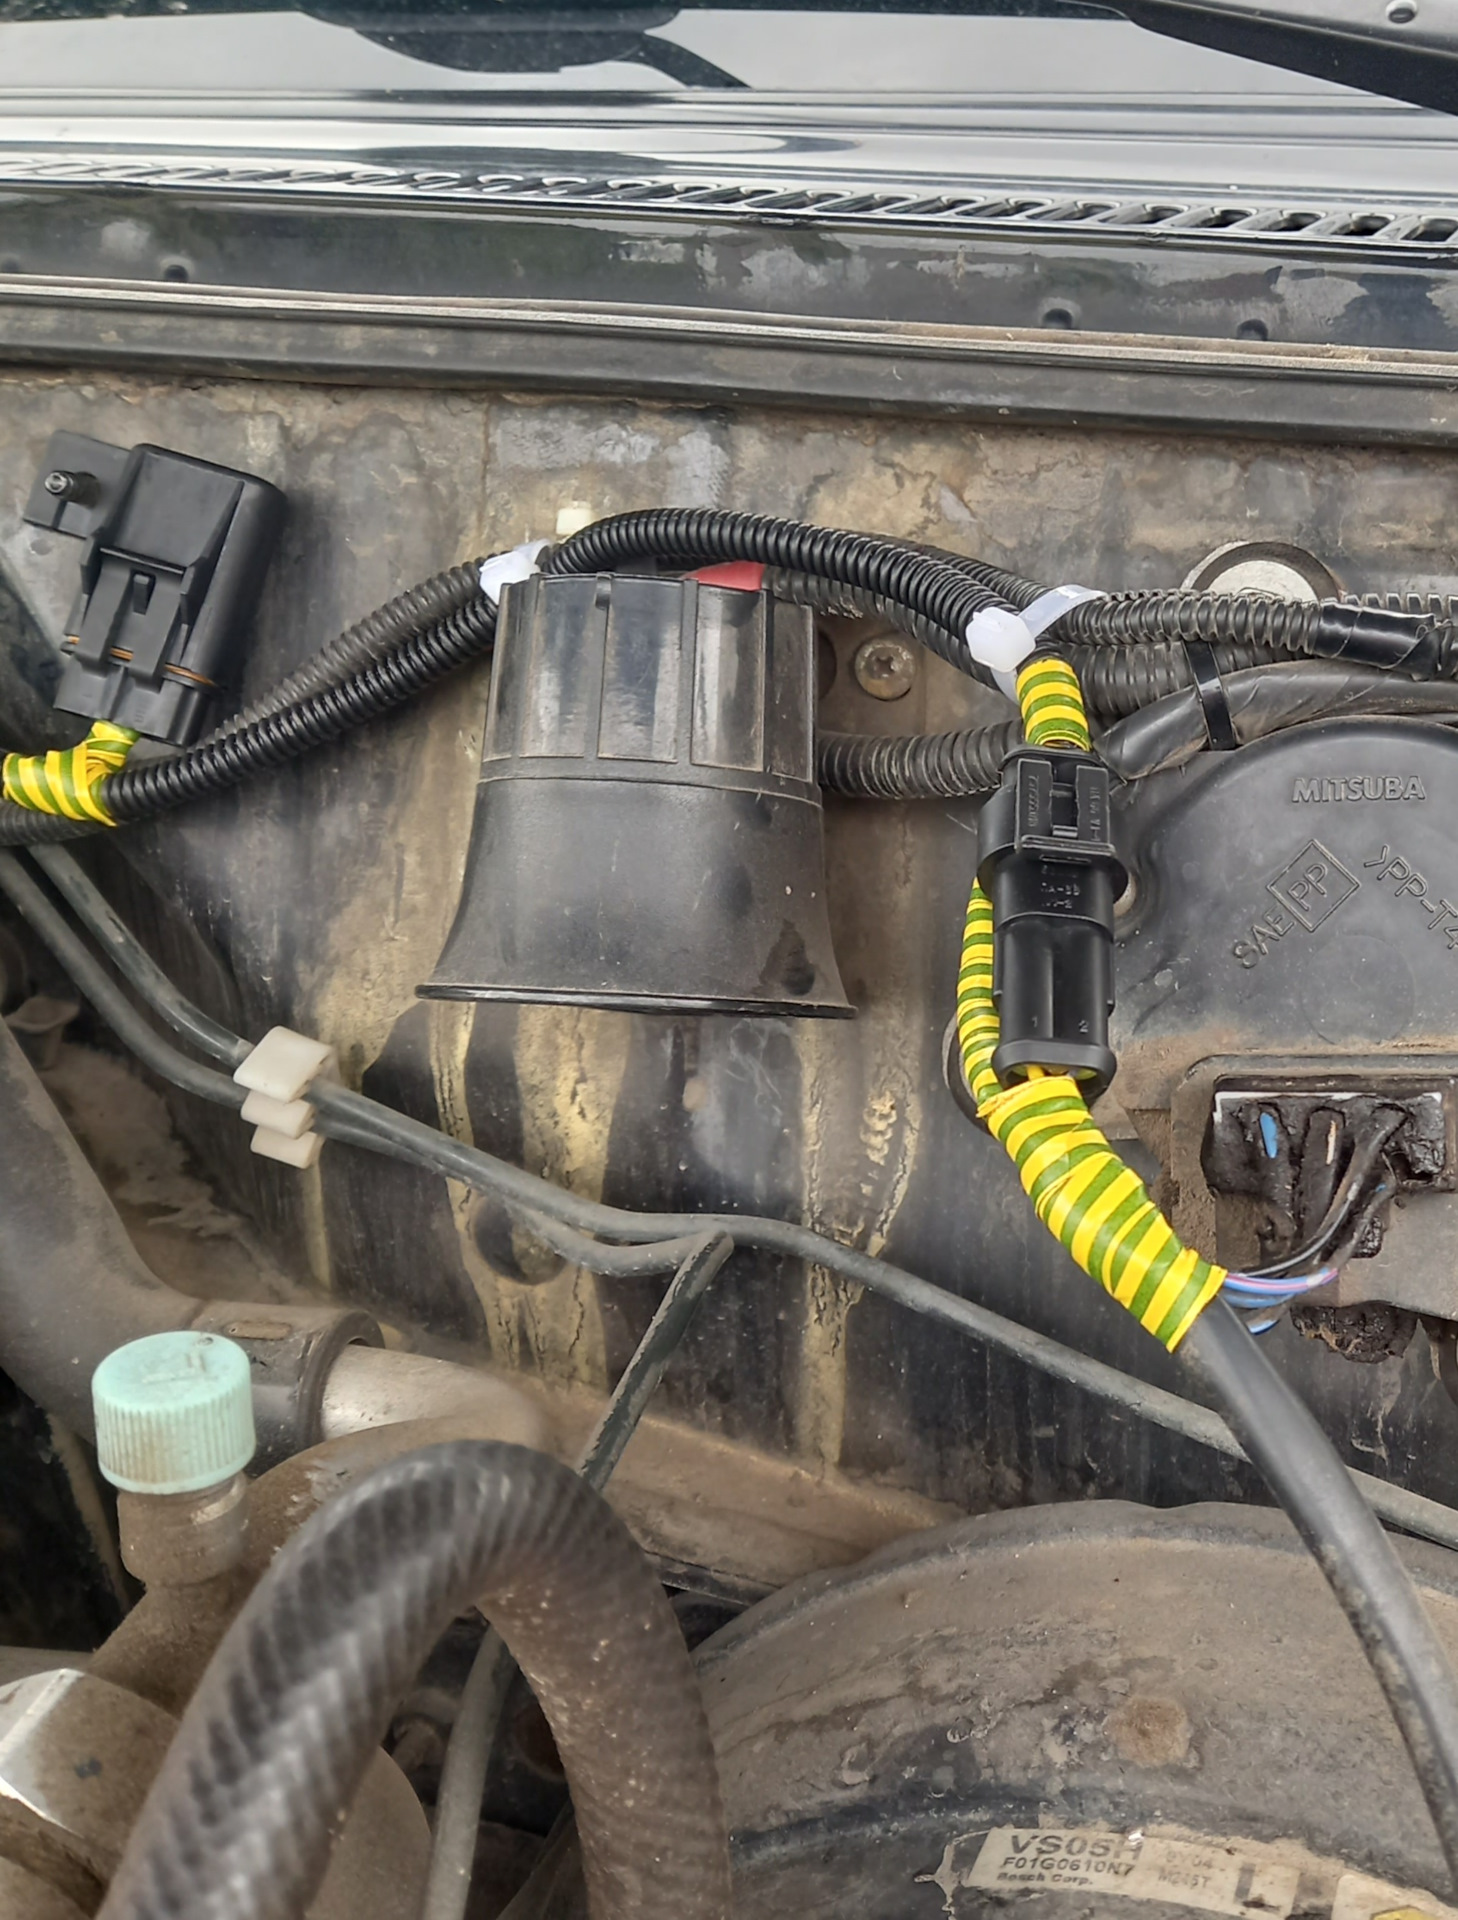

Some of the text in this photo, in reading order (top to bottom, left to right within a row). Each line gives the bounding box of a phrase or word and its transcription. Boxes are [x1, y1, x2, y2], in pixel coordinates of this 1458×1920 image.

[1292, 776, 1426, 803] MITSUBA
[1233, 862, 1329, 968] SAE PP
[1051, 1873, 1094, 1885] Corp.
